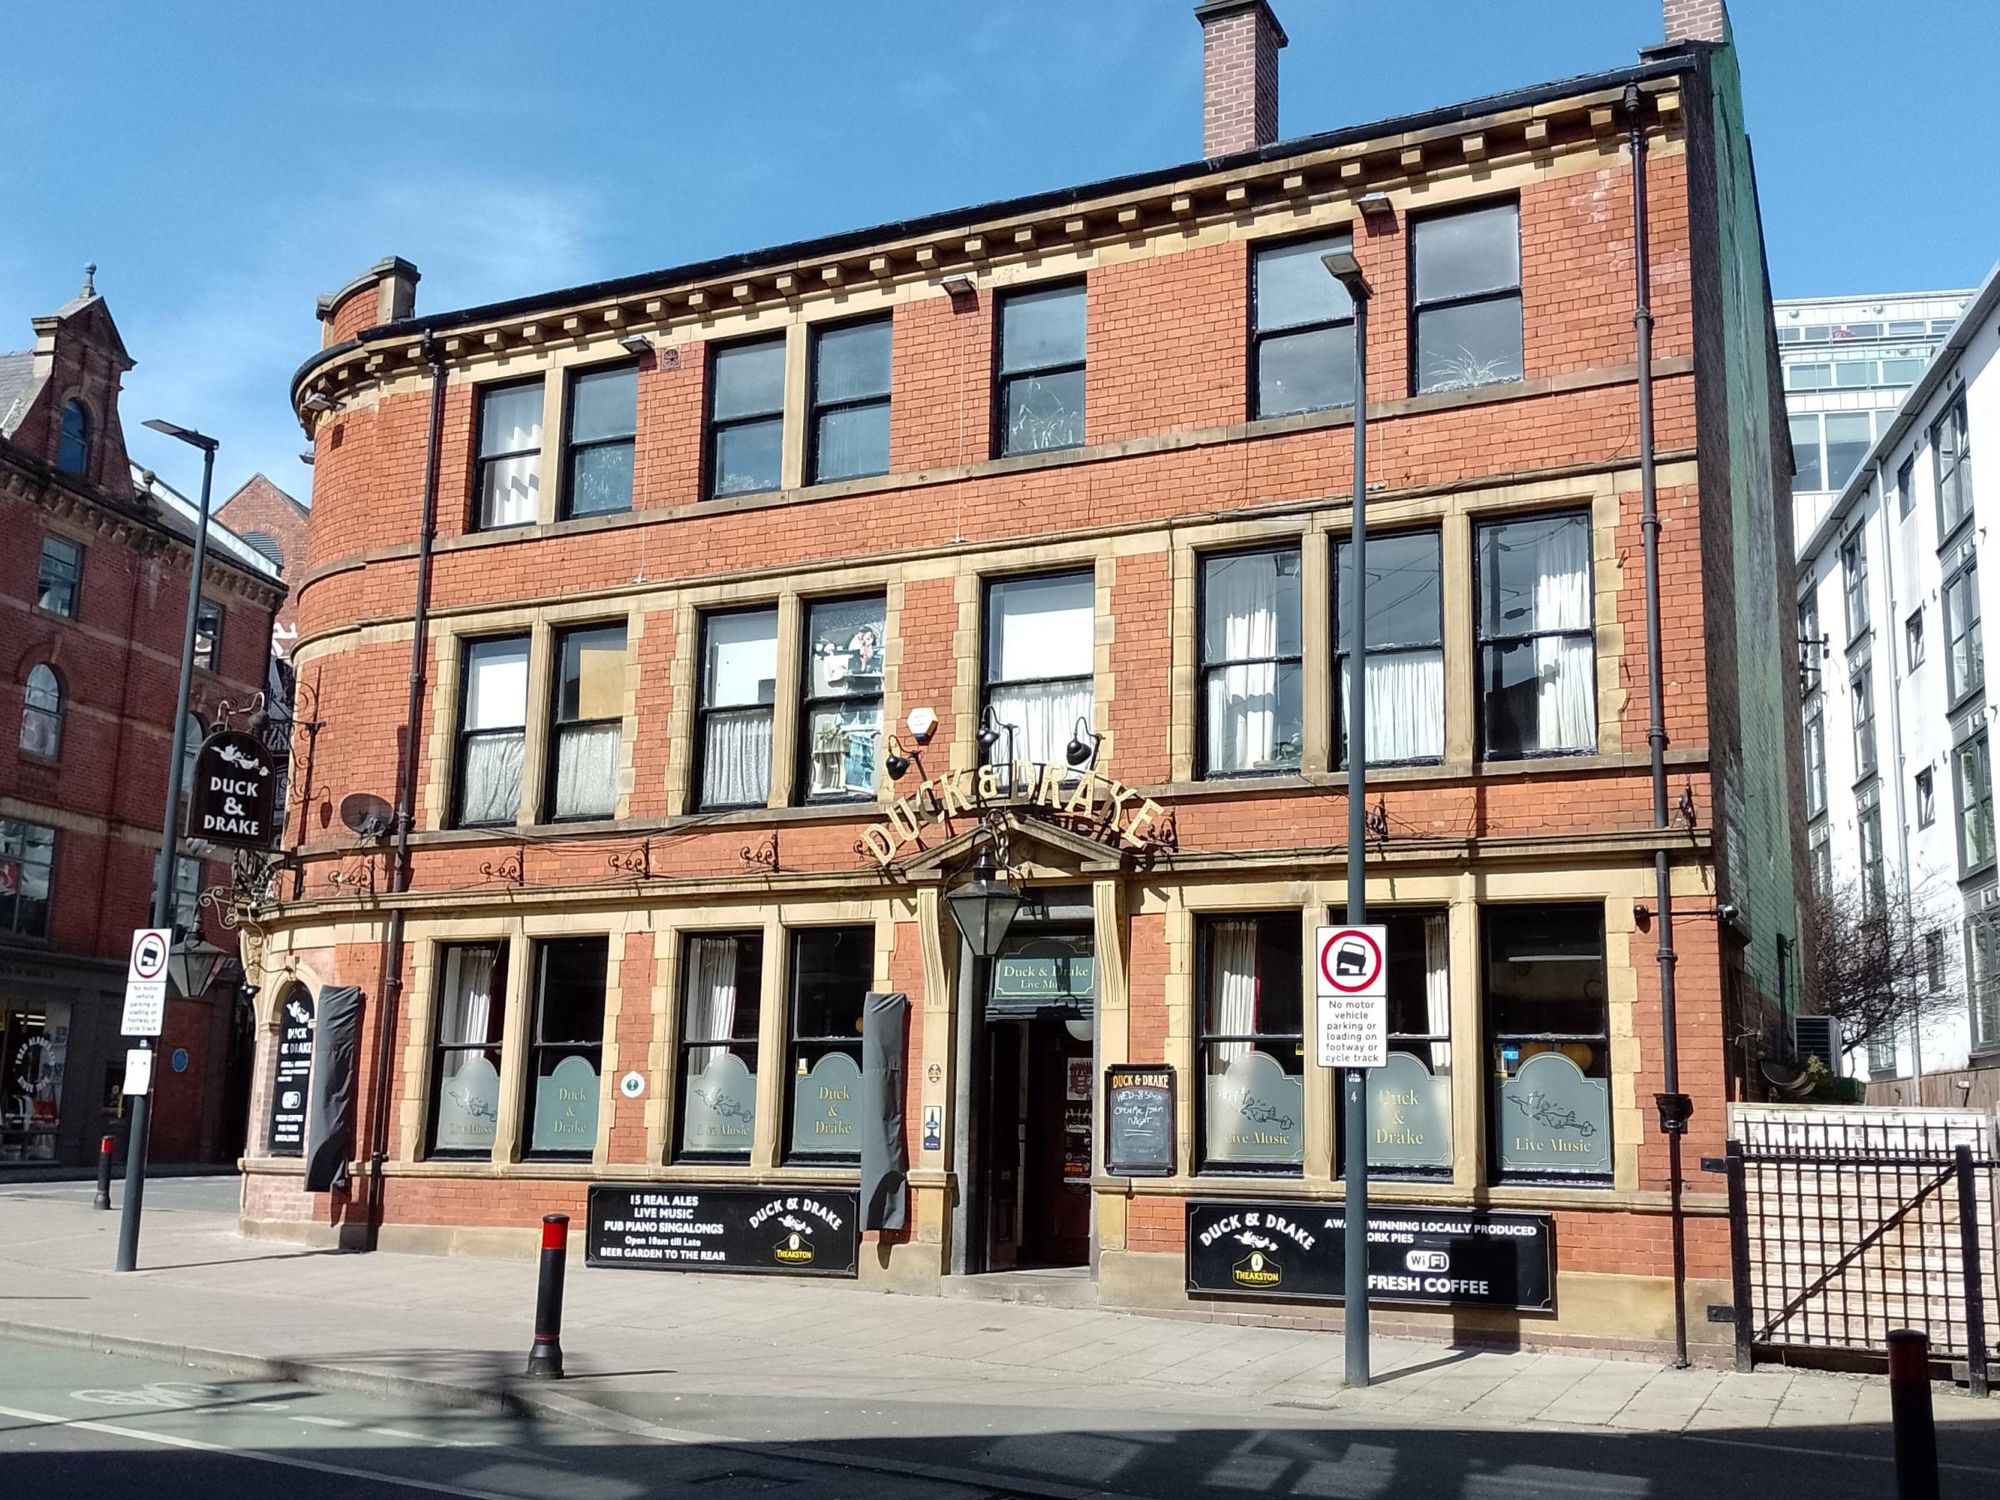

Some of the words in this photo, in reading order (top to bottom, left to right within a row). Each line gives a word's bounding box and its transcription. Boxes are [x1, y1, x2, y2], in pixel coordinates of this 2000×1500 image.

[210, 776, 259, 798] DUCK
[223, 796, 246, 816] &
[861, 768, 976, 866] DUCK
[978, 764, 1000, 800] &
[1011, 760, 1165, 849] DRAKE
[203, 814, 259, 836] DRAKE
[1003, 965, 1036, 977] Duck
[1038, 966, 1048, 977] &
[1020, 979, 1040, 989] Live
[1328, 1000, 1343, 1009] No
[1345, 1000, 1375, 1009] motor
[1334, 1011, 1369, 1019] vehicle
[287, 1026, 307, 1040] DUCK
[1327, 1022, 1363, 1031] parking
[1326, 1032, 1362, 1042] loading
[1326, 1043, 1365, 1052] footway
[1325, 1054, 1350, 1063] cycle
[1353, 1054, 1379, 1062] track
[1112, 1074, 1134, 1089] DUCK
[1134, 1074, 1142, 1086] &
[1142, 1074, 1169, 1089] DRAKE
[559, 1087, 586, 1101] Duck
[819, 1085, 850, 1100] Duck
[1350, 1090, 1358, 1103] 4
[1379, 1089, 1419, 1105] Duck
[566, 1104, 575, 1117] &
[828, 1103, 838, 1117] &
[1393, 1109, 1405, 1125] &
[554, 1119, 587, 1134] Drake
[815, 1119, 852, 1134] Drake
[1254, 1131, 1290, 1145] Music
[1376, 1128, 1424, 1145] Drake
[1515, 1138, 1544, 1151] Live
[1551, 1138, 1592, 1152] Music
[630, 1194, 641, 1205] 15
[643, 1195, 670, 1206] REAL
[672, 1196, 699, 1207] ALES
[634, 1208, 657, 1218] LIVE
[660, 1208, 694, 1219] MUSIC
[749, 1199, 783, 1229] DUCK
[786, 1197, 799, 1210] &
[803, 1198, 843, 1231] DRAKE
[604, 1221, 624, 1231] PUB
[625, 1221, 657, 1232] PIANO
[659, 1222, 724, 1234] SINGALONGS
[1200, 1214, 1242, 1247] DUCK
[1245, 1212, 1260, 1226] &
[1266, 1213, 1316, 1250] DRAKE
[1367, 1220, 1420, 1231] WINNING
[1422, 1222, 1472, 1234] LOCALLY
[1474, 1224, 1537, 1236] PRODUCED
[624, 1235, 646, 1246] Open
[670, 1237, 682, 1246] till
[683, 1238, 702, 1247] Late
[1367, 1232, 1389, 1243] ORK
[1391, 1233, 1414, 1244] PIES
[600, 1247, 622, 1257] BEER
[624, 1248, 663, 1258] GARDEN
[664, 1249, 678, 1259] TO
[680, 1250, 699, 1260] THE
[700, 1251, 726, 1261] REAR
[776, 1249, 812, 1259] THEAKSTON
[1235, 1269, 1279, 1281] THEAKSTON
[1367, 1275, 1420, 1291] FRESH
[1424, 1277, 1489, 1295] COFFEE
